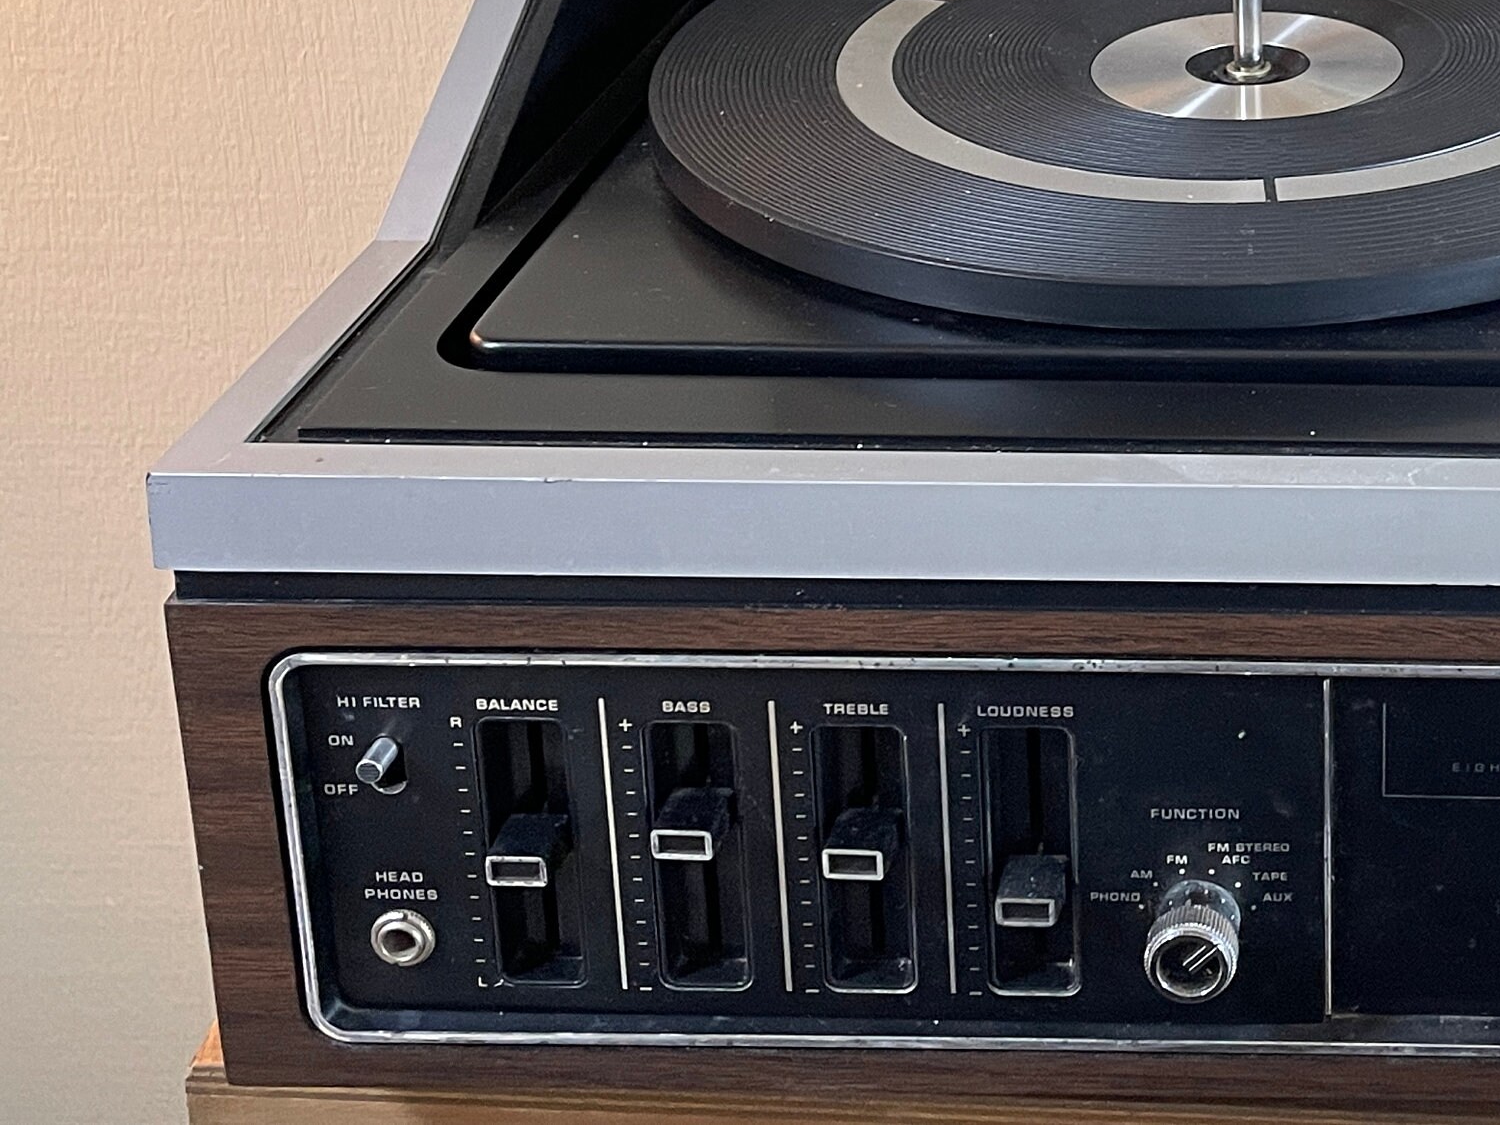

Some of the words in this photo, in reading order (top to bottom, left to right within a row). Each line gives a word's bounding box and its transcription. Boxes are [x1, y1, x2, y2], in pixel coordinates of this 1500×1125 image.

[337, 696, 357, 708] HI
[363, 697, 421, 709] FILTER
[476, 698, 558, 711] BALANCE
[662, 701, 710, 712] BASS
[823, 703, 889, 716] TREBLE
[977, 705, 1074, 718] LOUDNESS
[450, 717, 462, 728] R
[328, 734, 354, 746] ON
[324, 784, 359, 795] OFF
[1150, 808, 1240, 820] FUNCTION
[1207, 842, 1230, 853] FM
[1235, 842, 1290, 853] STEREO
[1166, 855, 1188, 865] FM
[1221, 855, 1250, 865] AFC
[375, 871, 423, 883] HEAD
[1130, 869, 1153, 880] AM
[1252, 872, 1288, 882] TAPE
[364, 888, 438, 900] PHONES
[1089, 891, 1141, 903] PHONO
[1262, 892, 1293, 903] AUX
[478, 976, 488, 987] L
